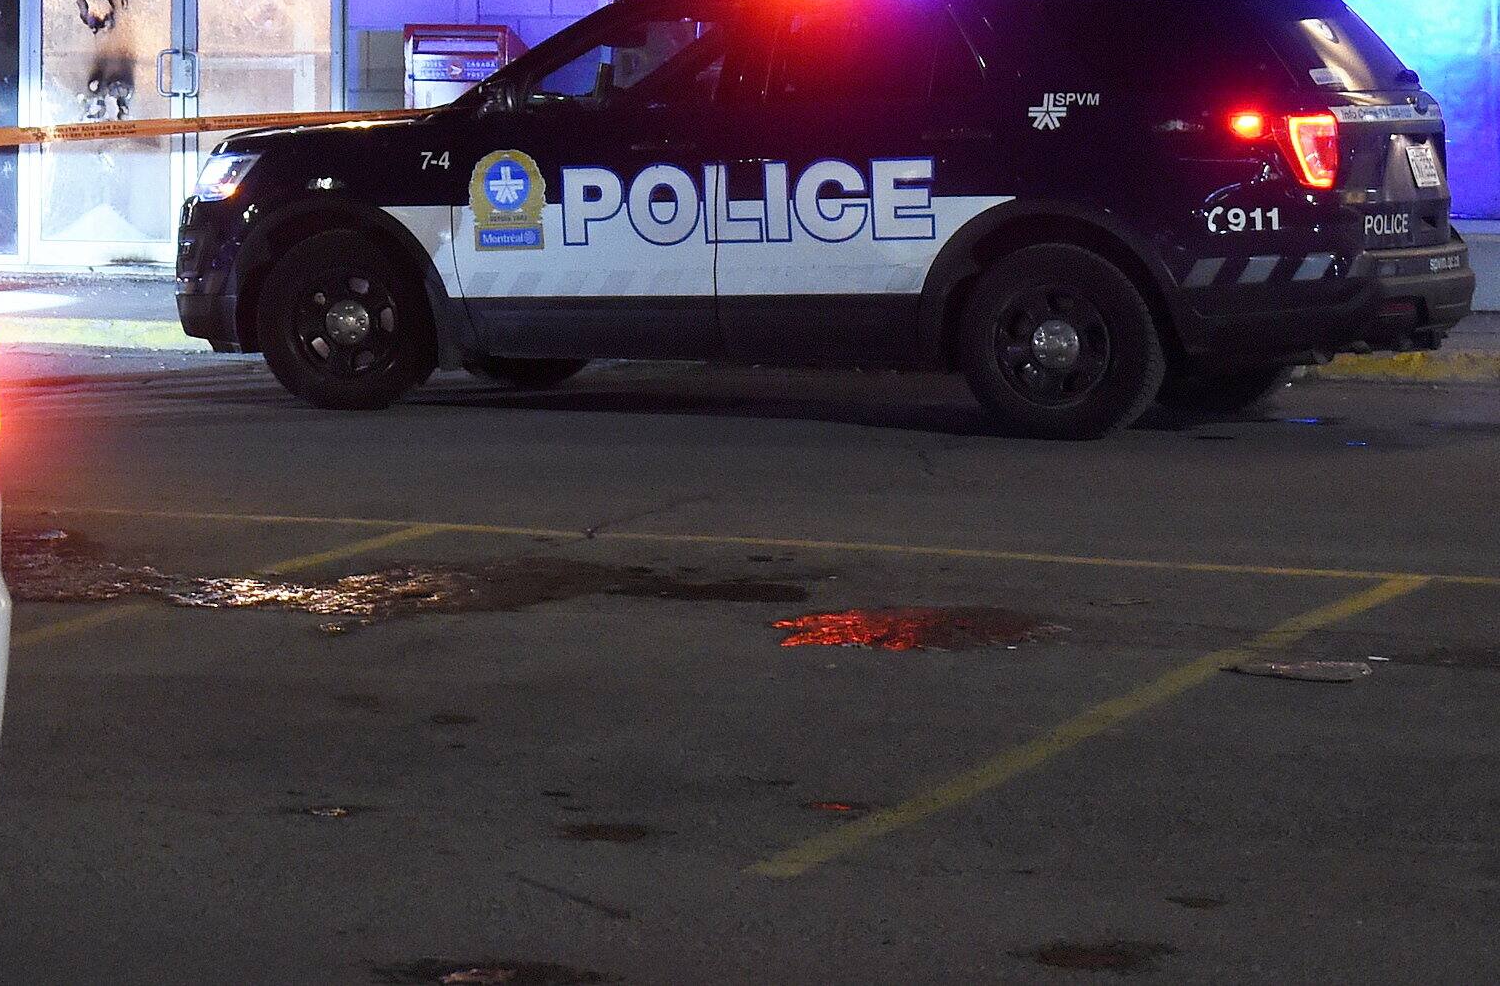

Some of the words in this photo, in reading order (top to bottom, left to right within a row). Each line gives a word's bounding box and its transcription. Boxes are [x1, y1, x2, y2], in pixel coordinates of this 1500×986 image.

[1055, 92, 1100, 106] SPVM
[420, 150, 450, 170] 7-4
[560, 156, 936, 246] POLICE
[1227, 207, 1280, 231] 911
[1364, 213, 1409, 235] POLICE
